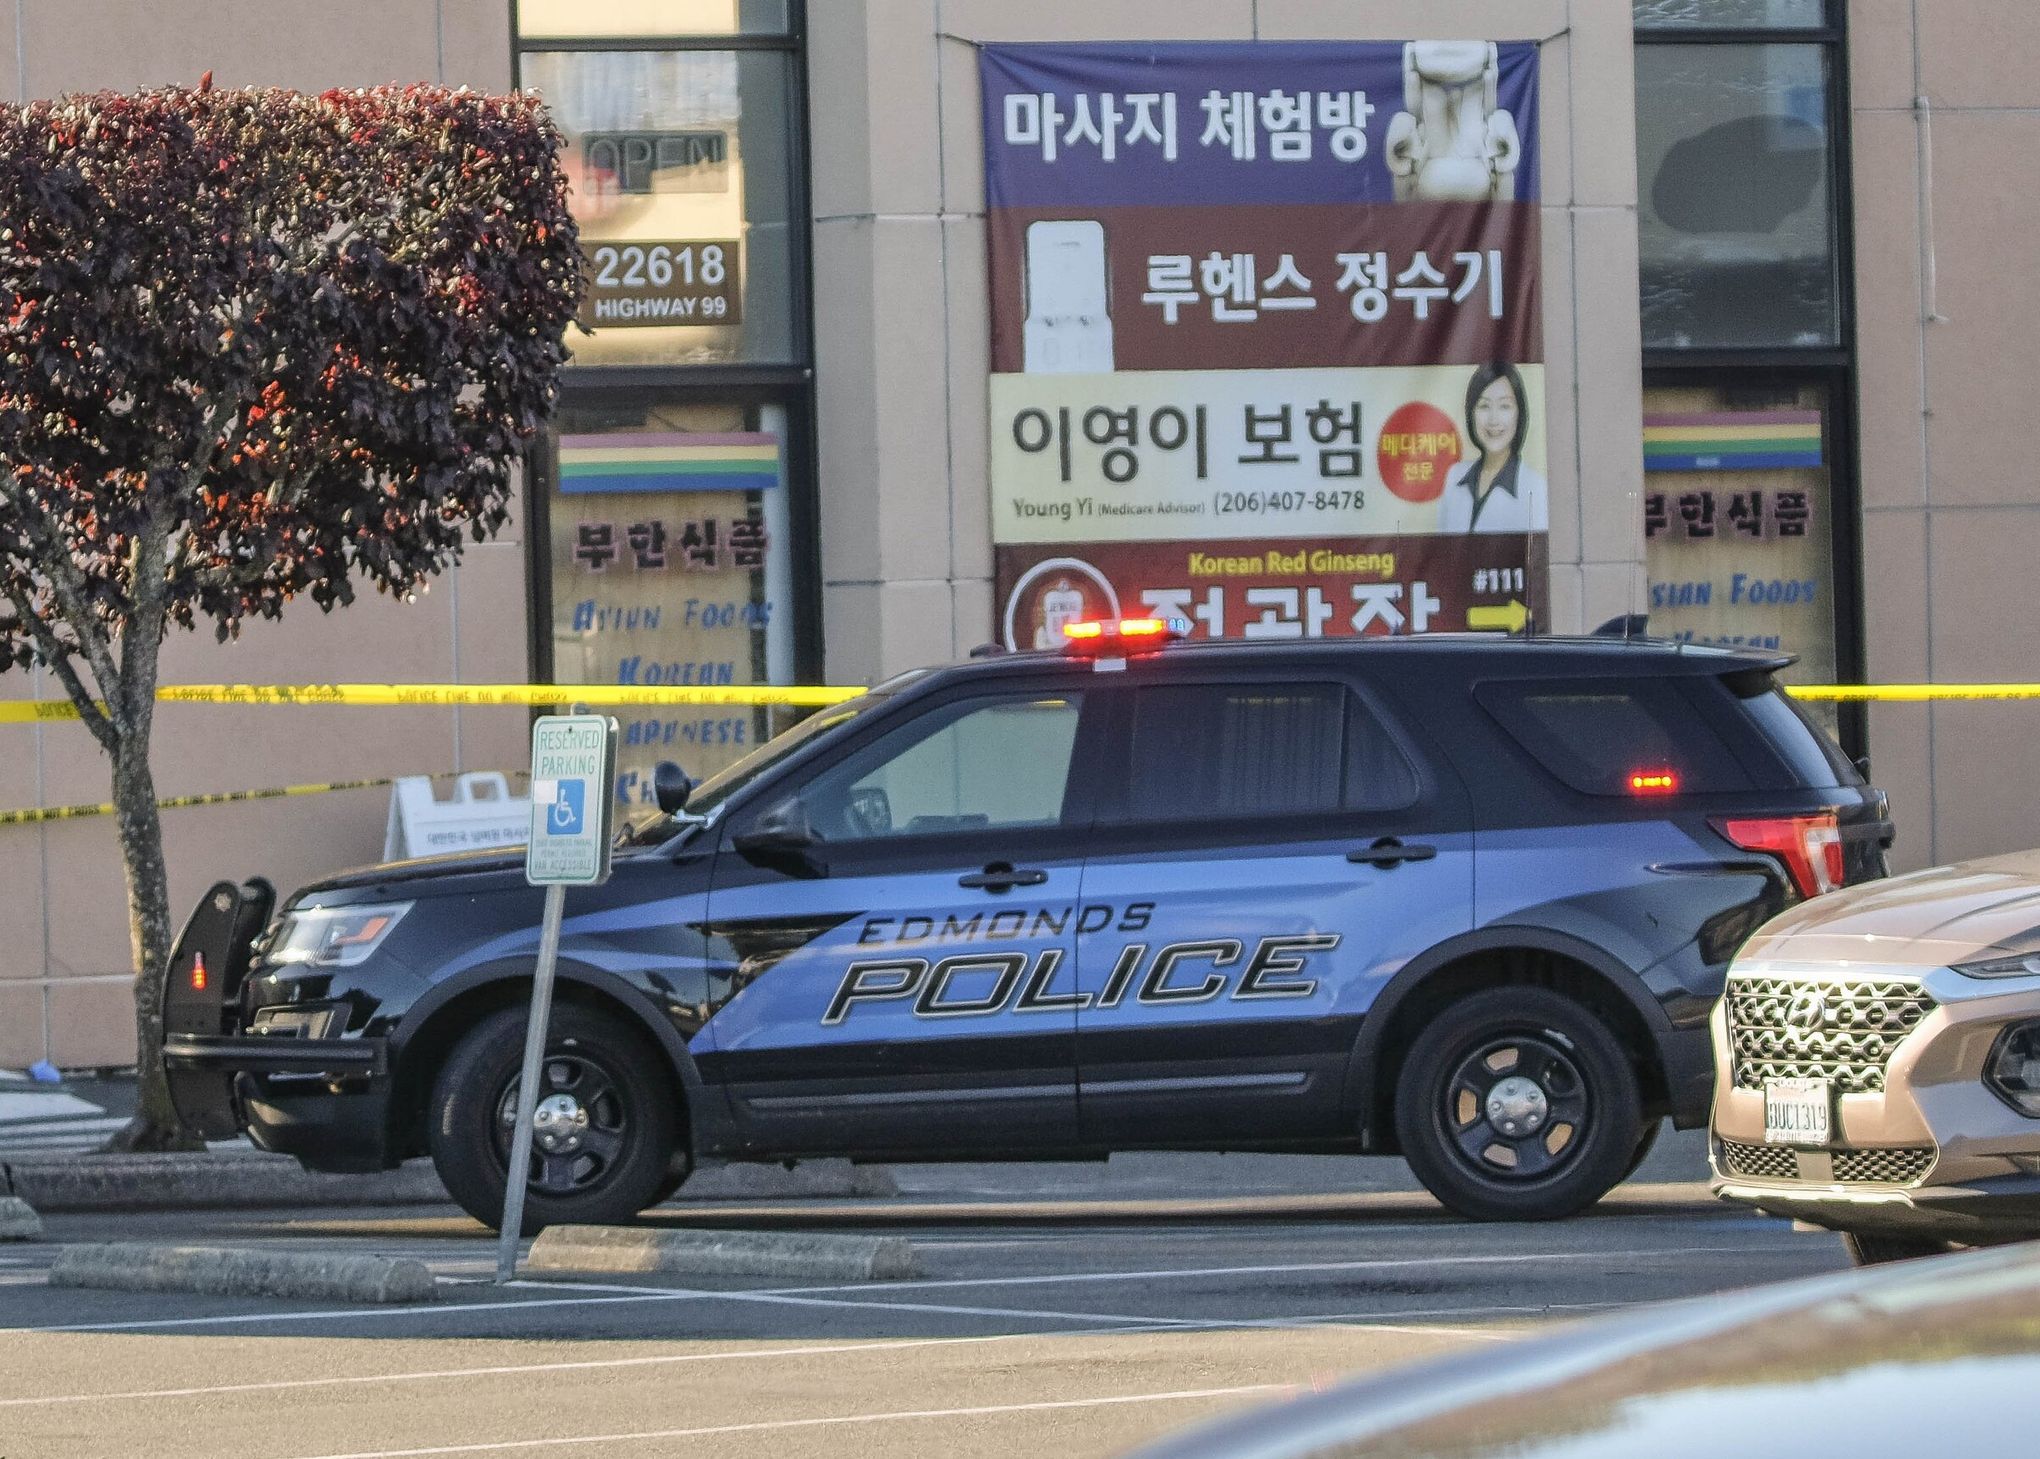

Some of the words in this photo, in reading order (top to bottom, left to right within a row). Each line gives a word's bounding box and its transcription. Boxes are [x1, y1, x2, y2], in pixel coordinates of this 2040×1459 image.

[1005, 91, 1178, 162] 마사지
[1200, 88, 1376, 162] 체험방
[595, 245, 725, 287] 22618
[1142, 250, 1317, 325] 루헨스
[1336, 249, 1504, 323] 정수기
[595, 296, 696, 318] HIGHWAY
[702, 296, 727, 317] 99
[1012, 403, 1207, 484] 이영이
[1237, 399, 1364, 479] 보험
[1013, 498, 1071, 520] Young
[1077, 497, 1094, 516] Yi
[1098, 502, 1152, 517] (Medicare
[1213, 490, 1366, 517] (206)407-8478
[1188, 552, 1263, 576] Korean
[1267, 551, 1307, 574] Red
[1310, 549, 1395, 578] Ginseng
[1472, 568, 1524, 592] #111
[540, 731, 600, 750] RESERVED
[541, 755, 596, 776] PARKING
[857, 902, 1157, 947] EDMONDS
[821, 933, 1342, 1025] POLICE
